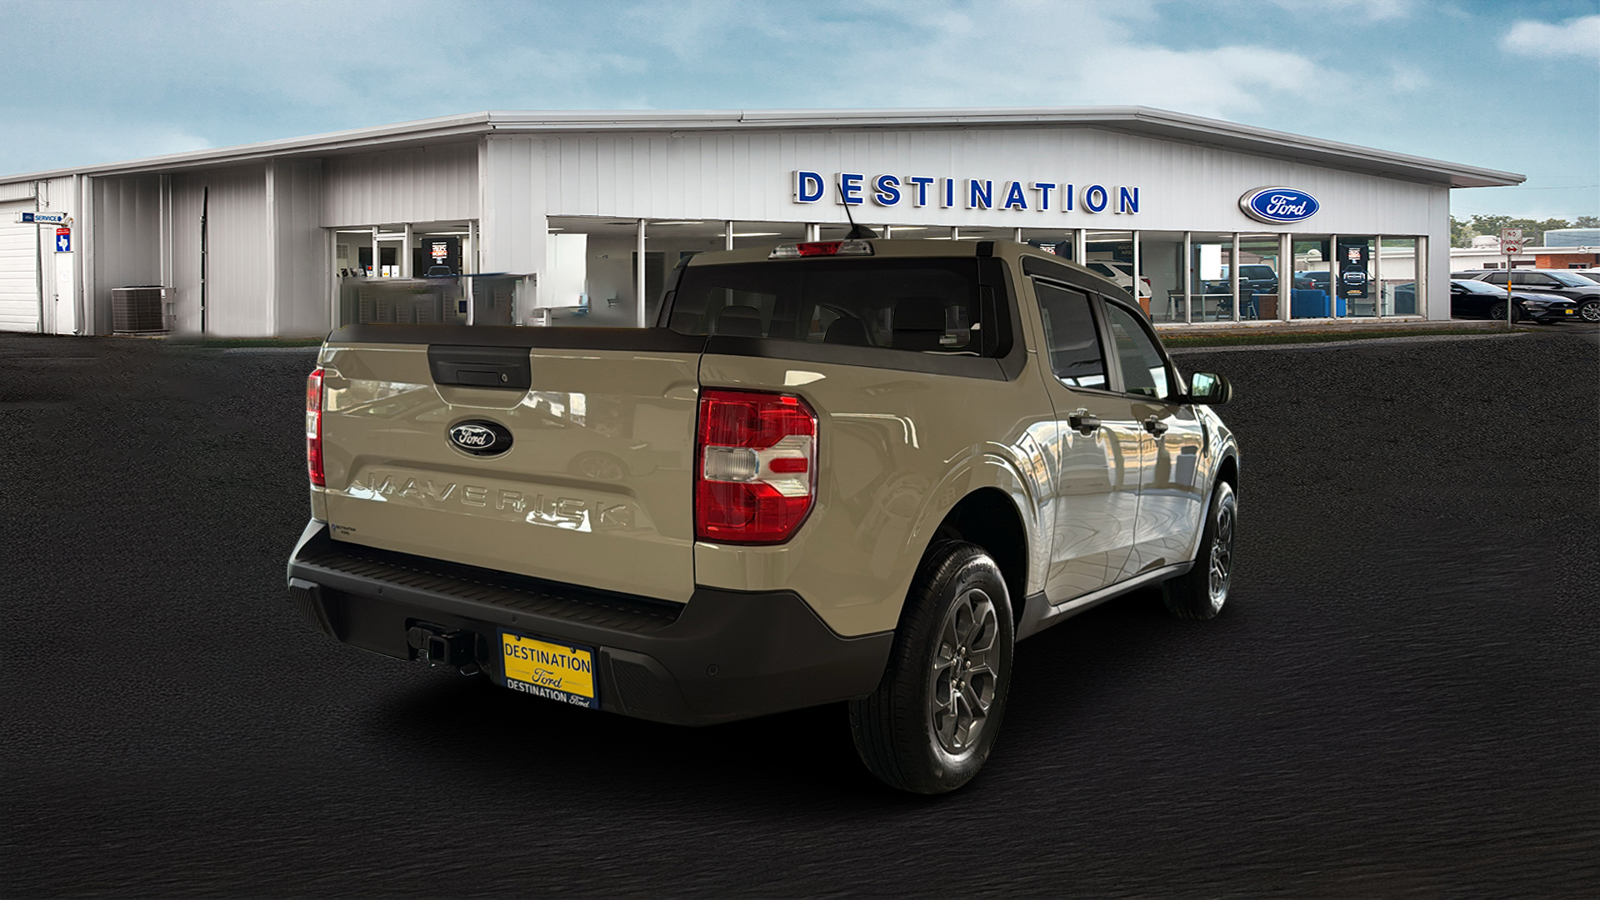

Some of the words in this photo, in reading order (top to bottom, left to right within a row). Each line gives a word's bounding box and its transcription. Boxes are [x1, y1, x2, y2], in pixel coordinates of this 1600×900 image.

[796, 171, 1140, 214] DESTINATION
[1266, 194, 1307, 215] Ford
[458, 427, 487, 446] Ford
[367, 472, 627, 525] MAVERICK
[505, 643, 590, 673] DESTINATION
[532, 667, 563, 688] Ford
[507, 679, 567, 702] DESTINATION
[569, 695, 590, 708] Ford
